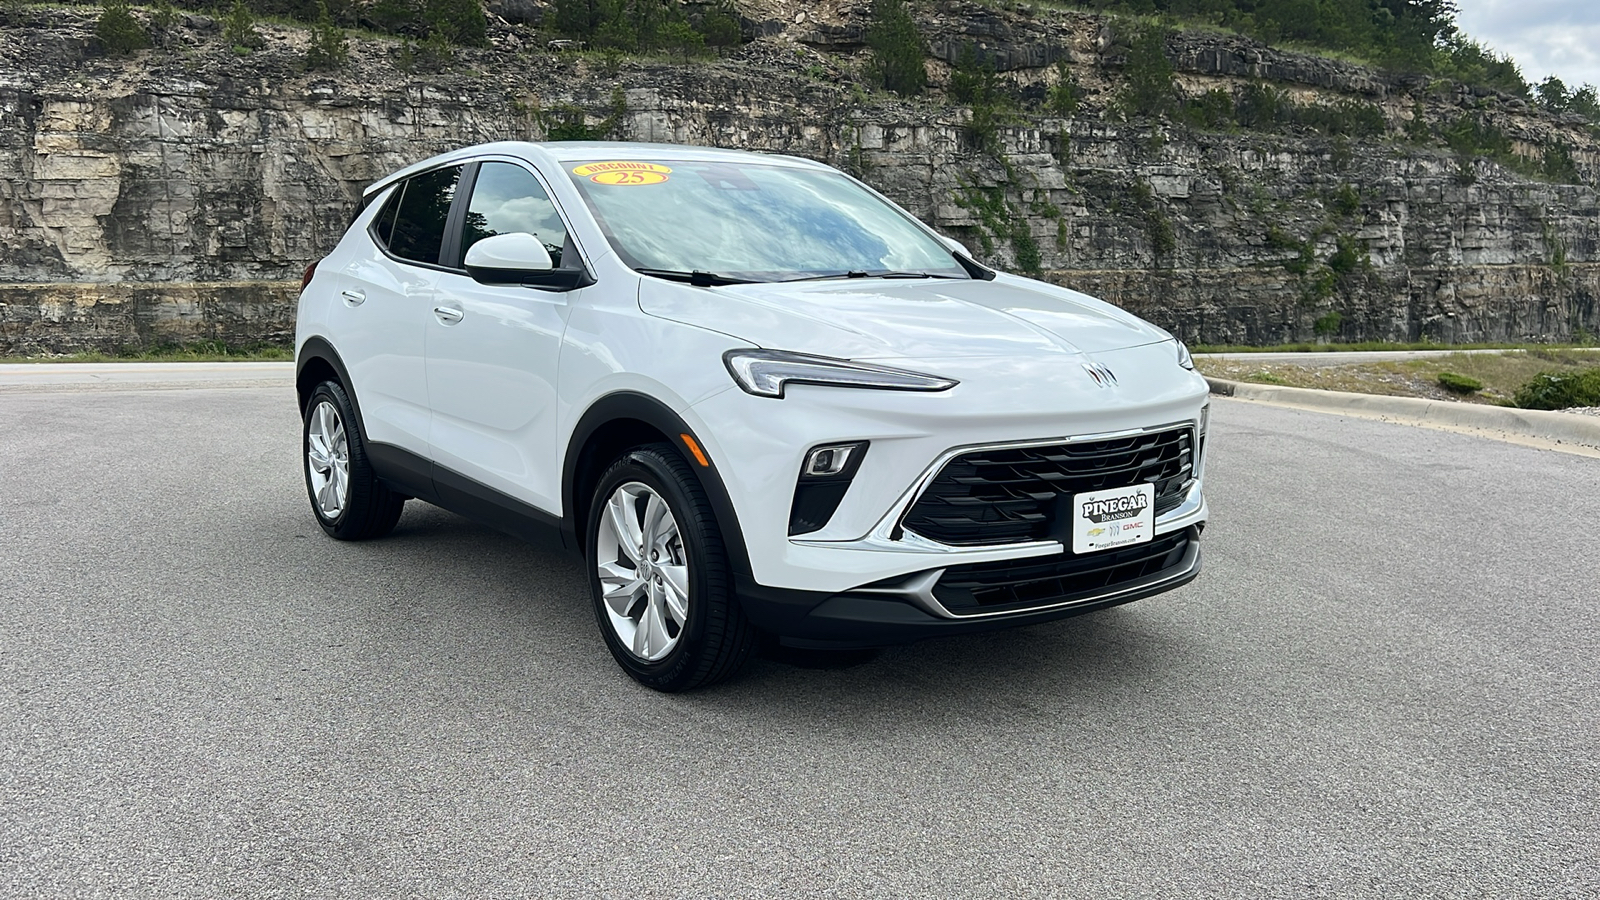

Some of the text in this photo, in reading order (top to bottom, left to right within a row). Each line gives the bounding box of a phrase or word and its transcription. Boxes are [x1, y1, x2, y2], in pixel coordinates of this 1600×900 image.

[584, 162, 655, 172] DISCOUNT
[615, 171, 645, 184] 25
[1083, 494, 1147, 518] PINEGAR
[1101, 511, 1133, 522] BRANSON
[1123, 521, 1144, 531] GMC
[1094, 537, 1136, 549] PinegarBranson.com
[657, 651, 691, 685] VANTAGE
